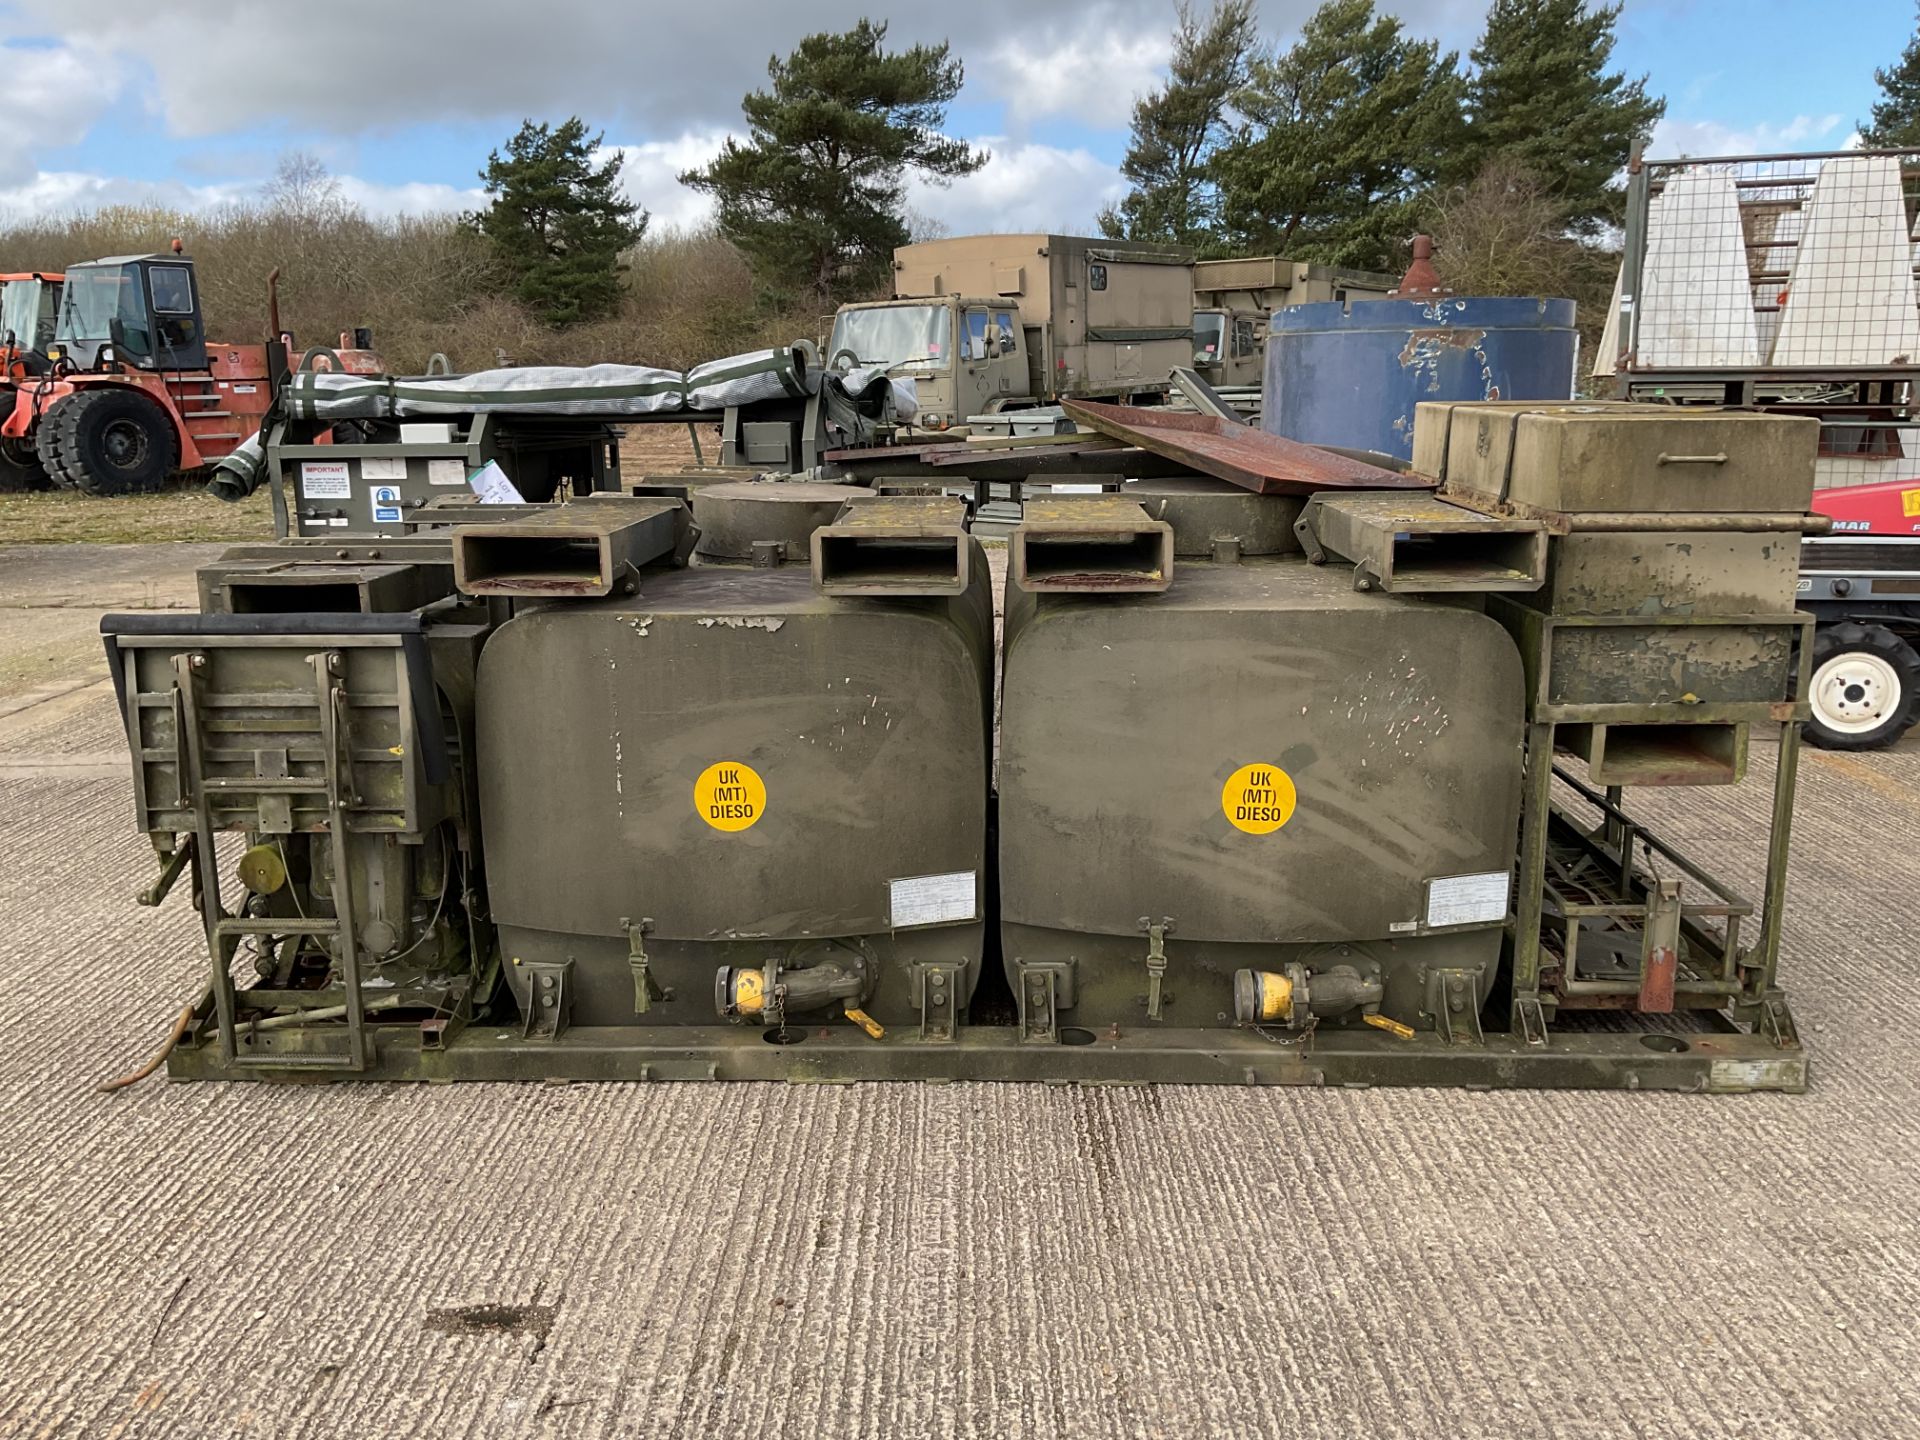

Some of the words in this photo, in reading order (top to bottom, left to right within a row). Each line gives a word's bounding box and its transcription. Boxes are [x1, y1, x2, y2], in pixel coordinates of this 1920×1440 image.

[719, 770, 739, 784] UK
[1250, 771, 1271, 786] UK
[714, 786, 747, 803] (MT)
[1242, 788, 1277, 806] (MT)
[710, 804, 753, 819] DIESO
[1236, 806, 1281, 822] DIESO
